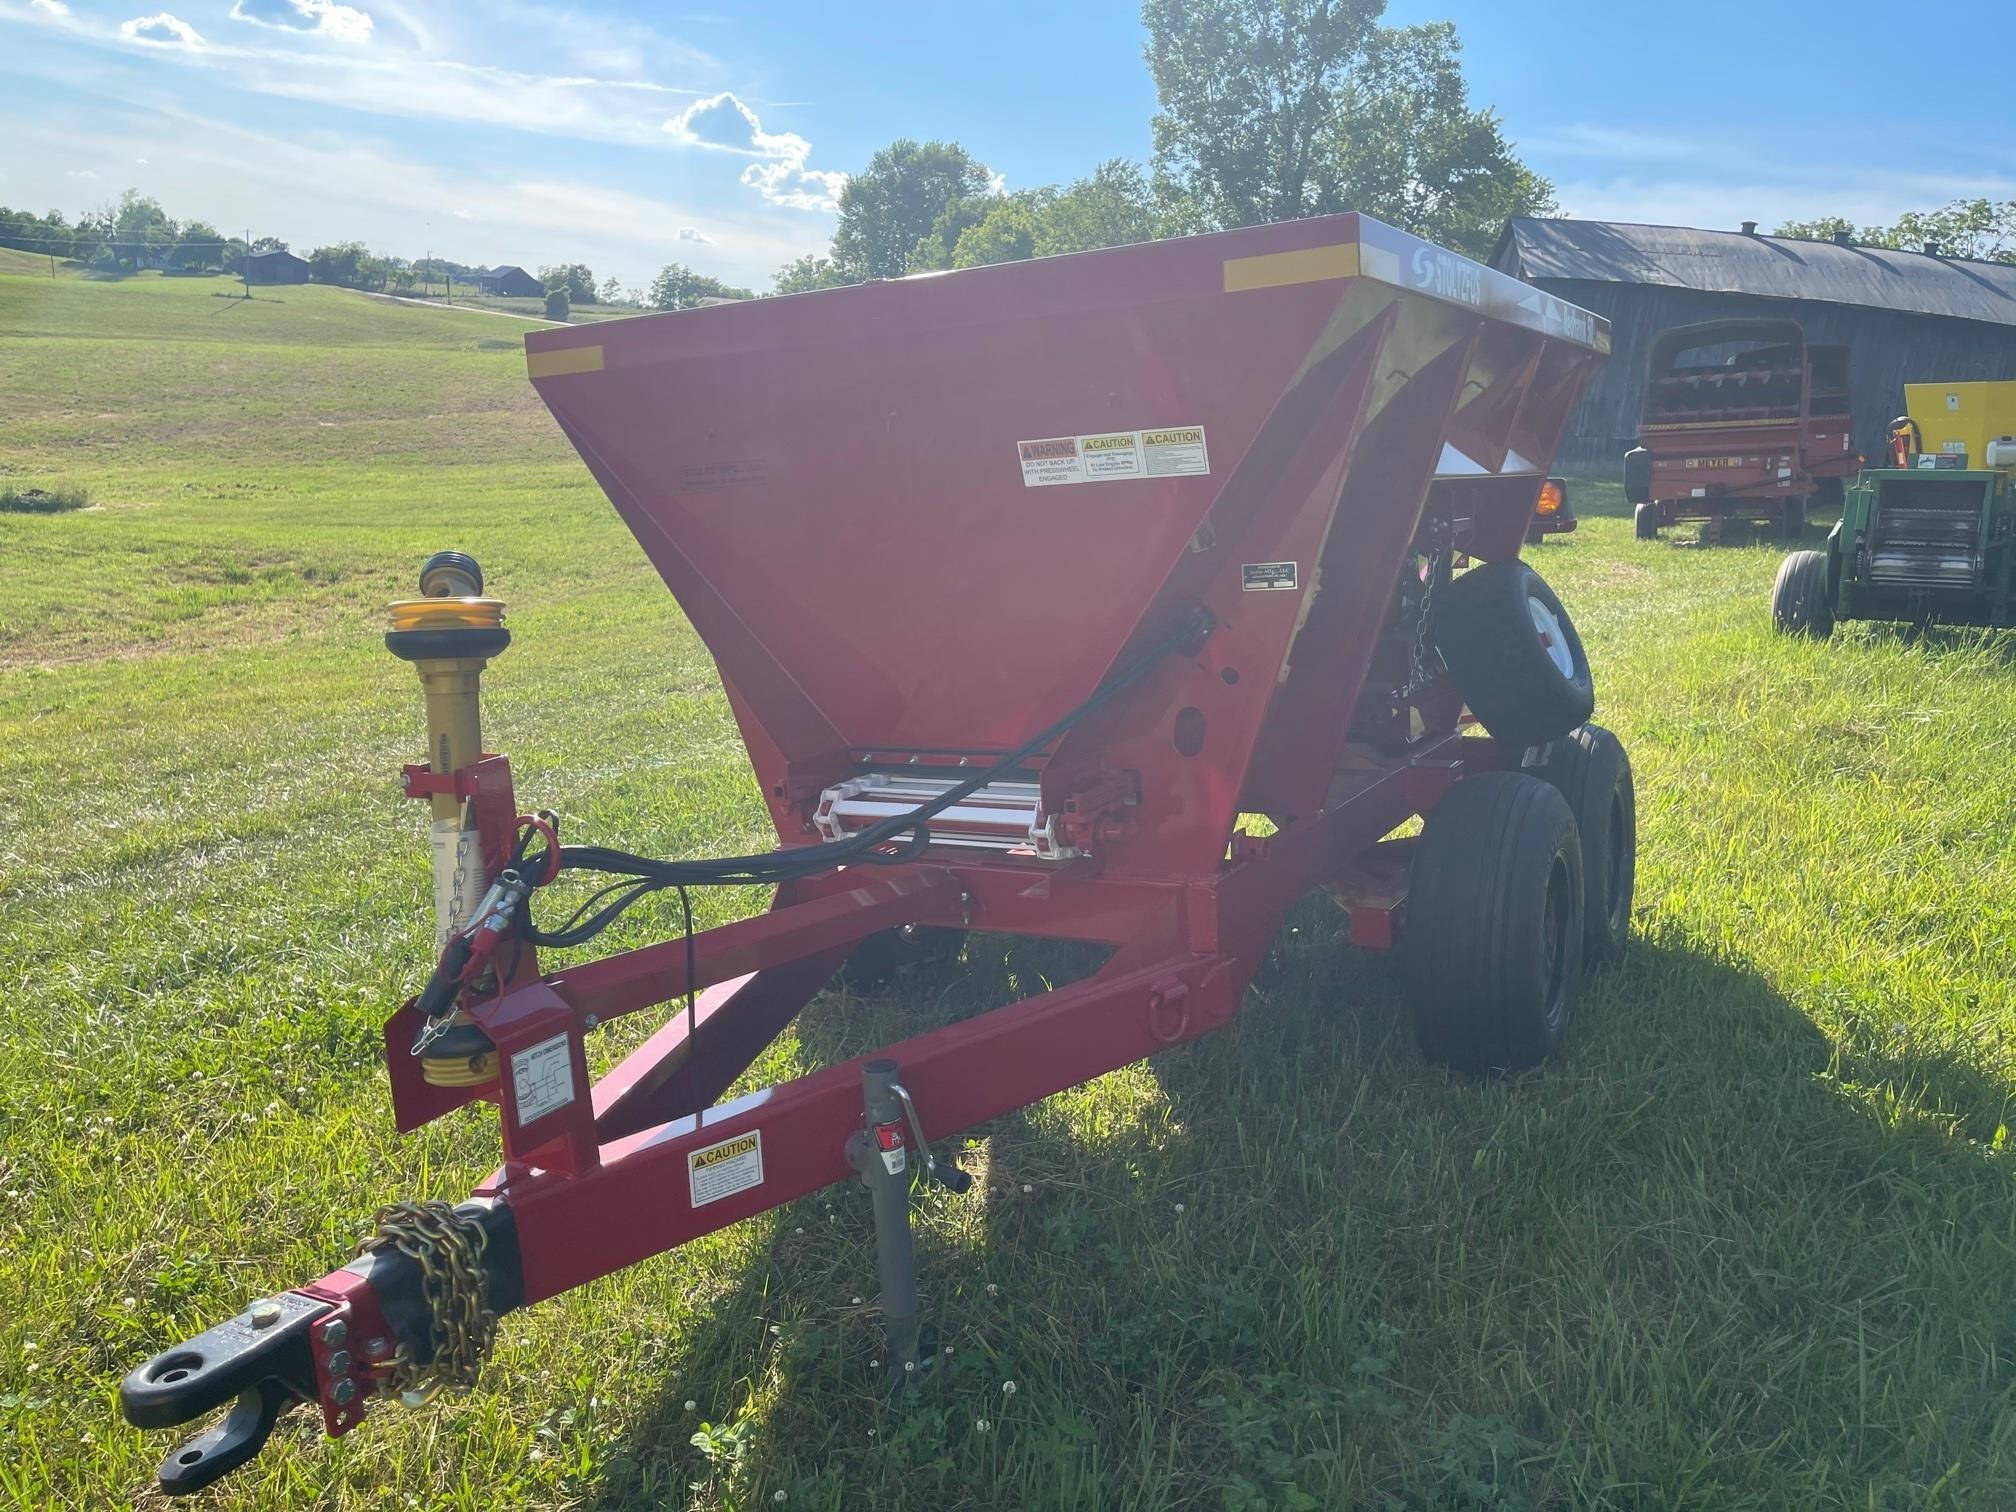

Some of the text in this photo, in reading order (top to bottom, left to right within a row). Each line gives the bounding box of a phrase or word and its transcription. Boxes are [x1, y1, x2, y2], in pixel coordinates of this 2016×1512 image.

[1093, 437, 1133, 449] CAUTION
[1155, 431, 1200, 444] CAUTION
[1031, 441, 1075, 457] WARNING
[1698, 458, 1729, 467] MEYER
[706, 1137, 756, 1163] CAUTION
